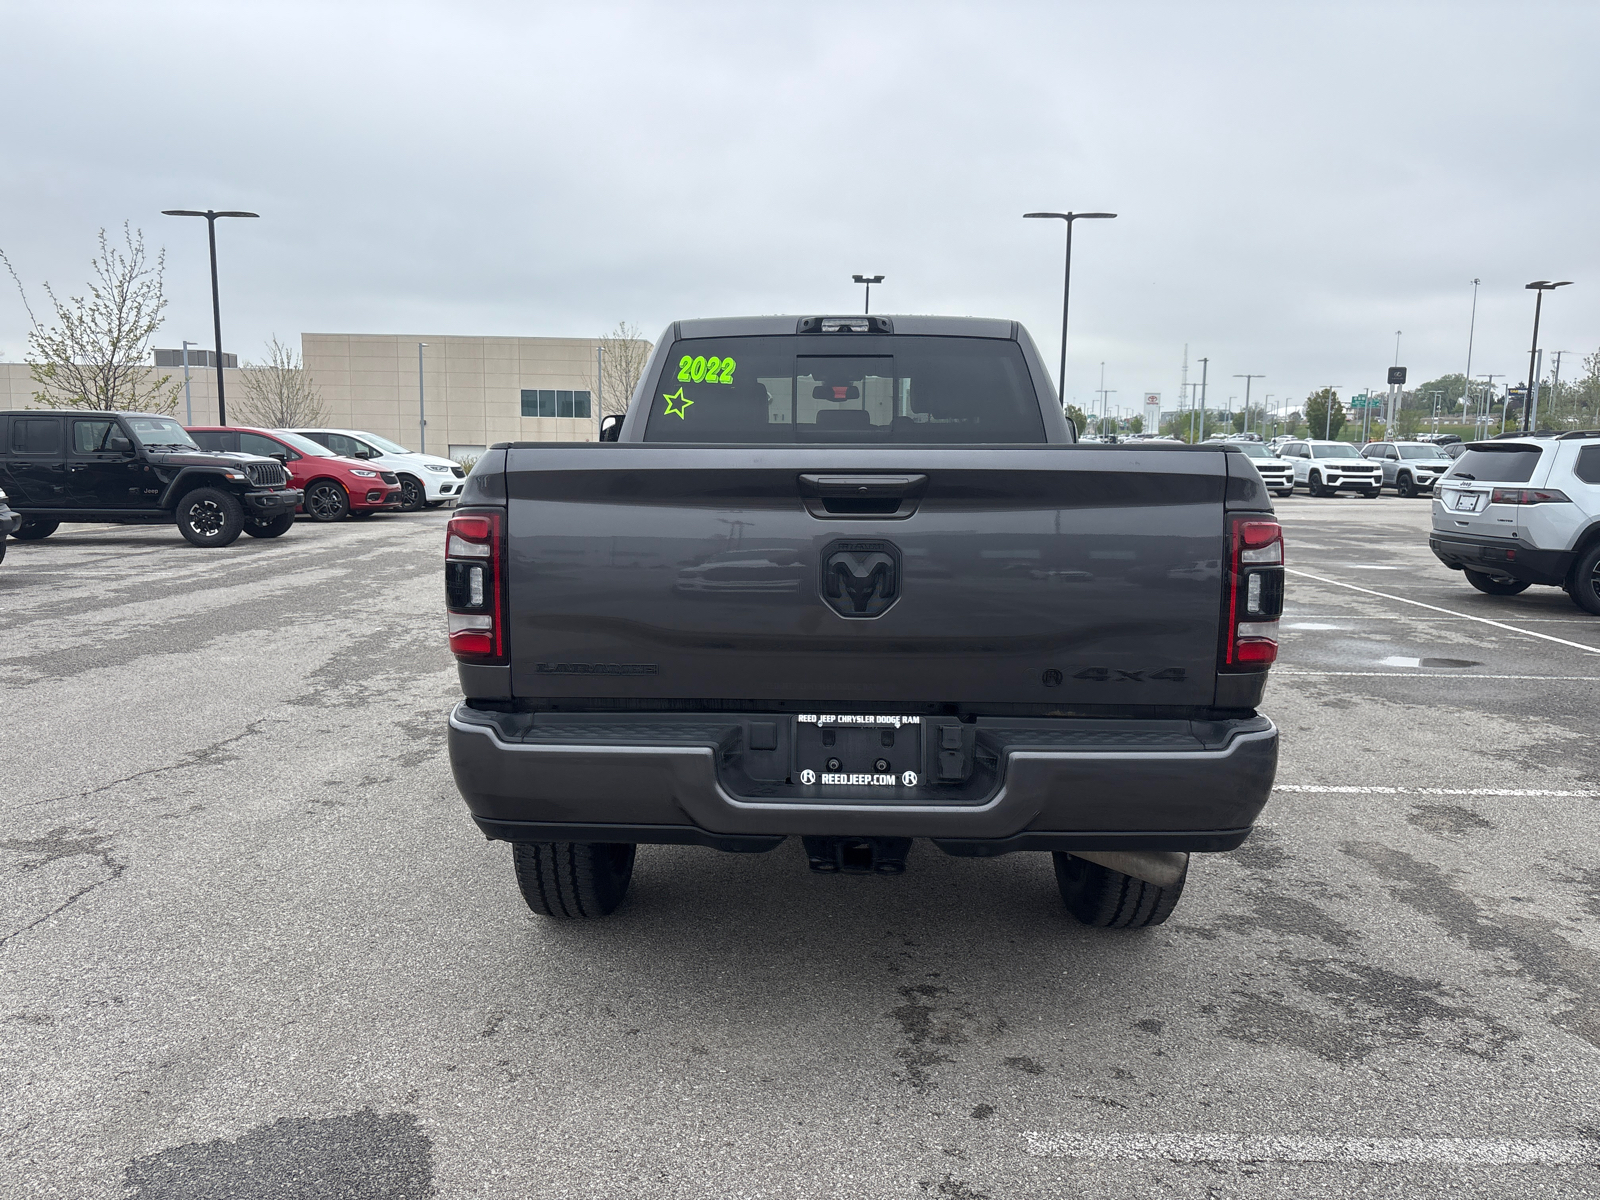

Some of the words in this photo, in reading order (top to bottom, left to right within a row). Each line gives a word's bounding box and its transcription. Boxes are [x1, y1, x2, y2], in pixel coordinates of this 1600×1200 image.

[677, 355, 736, 384] 2022
[798, 714, 817, 723] REED
[818, 715, 836, 724] JEEP
[837, 715, 875, 724] CHRYSLER
[876, 716, 901, 725] DODGE
[902, 716, 920, 724] RAM
[821, 773, 896, 786] REEDJEEP.COM
